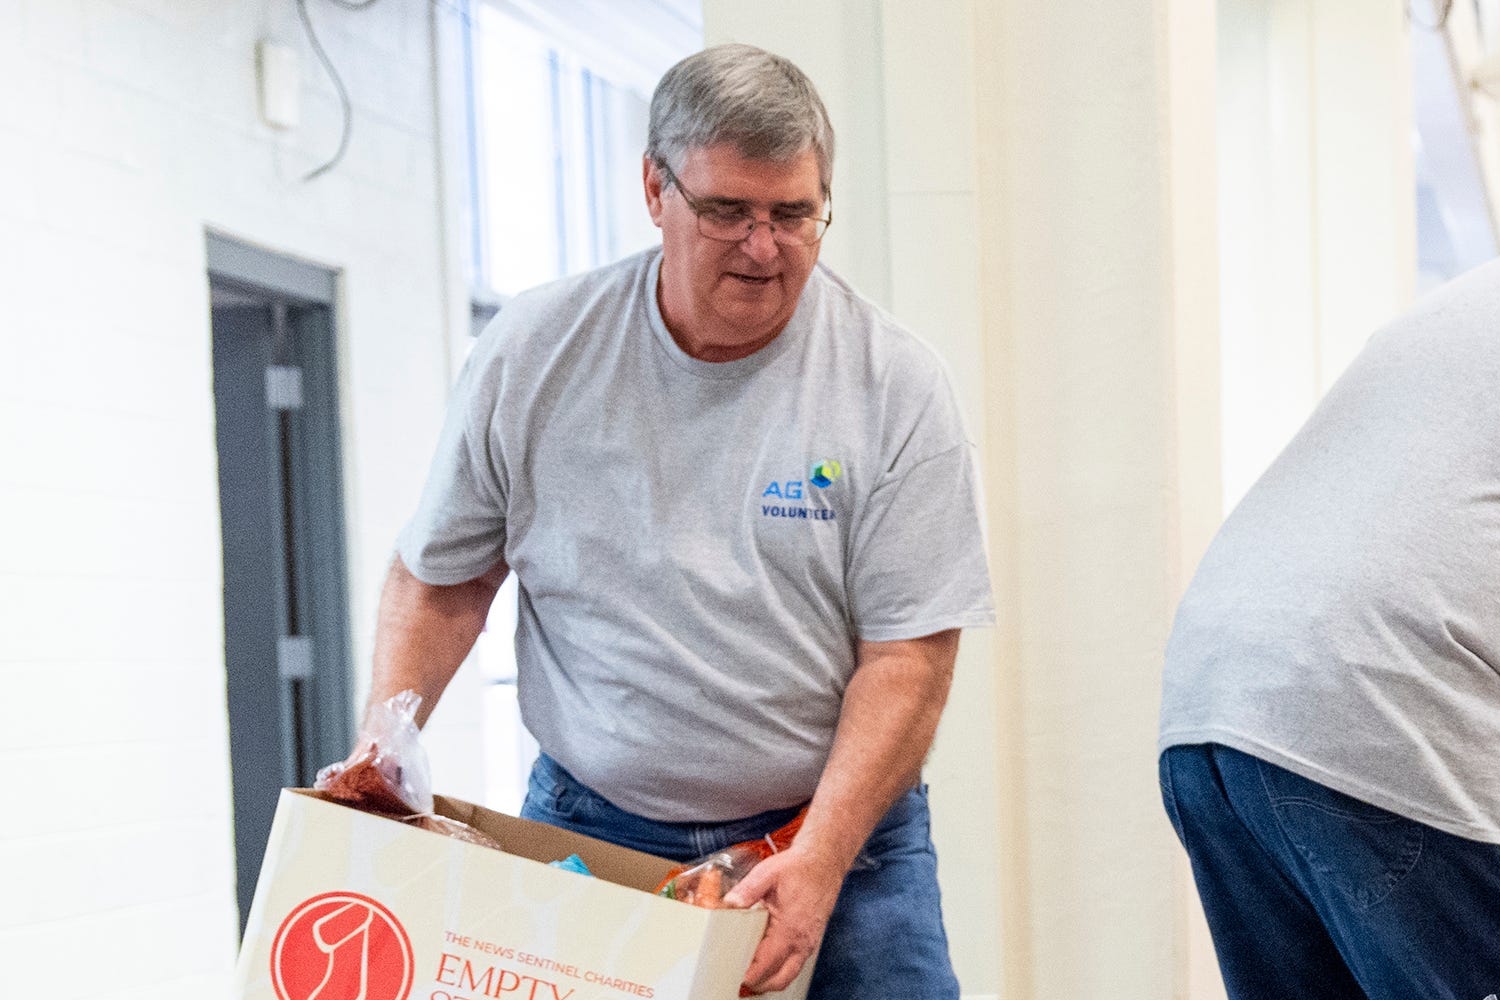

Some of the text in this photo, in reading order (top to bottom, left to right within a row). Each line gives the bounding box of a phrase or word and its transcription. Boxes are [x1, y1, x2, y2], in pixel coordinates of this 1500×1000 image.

[762, 480, 803, 500] AG
[445, 931, 655, 999] THE NEWS SENTINEL CHARITIES
